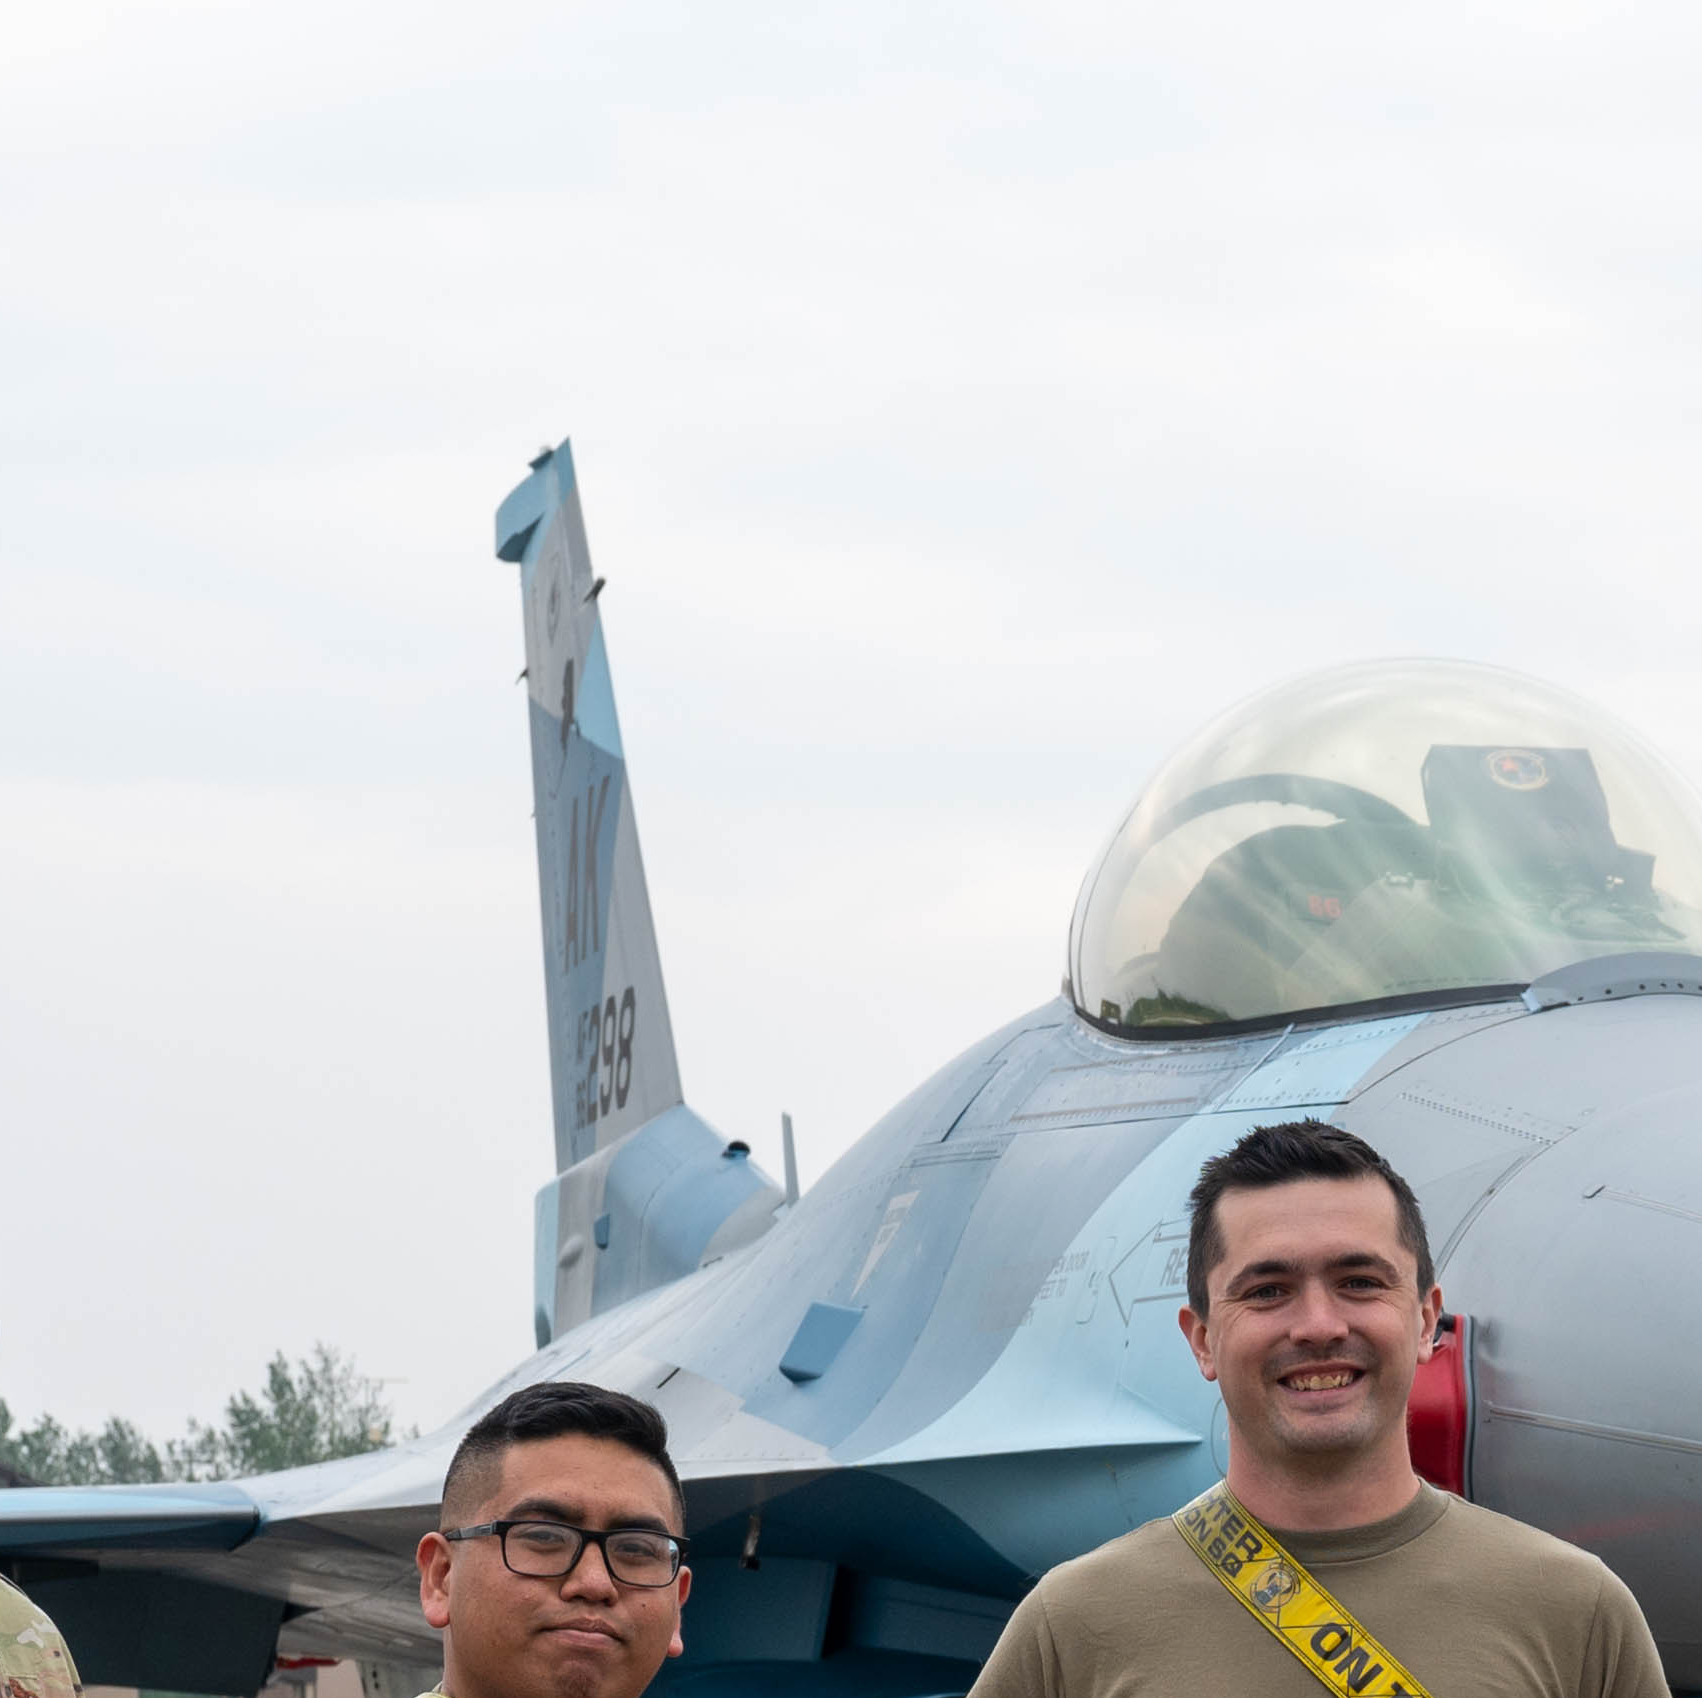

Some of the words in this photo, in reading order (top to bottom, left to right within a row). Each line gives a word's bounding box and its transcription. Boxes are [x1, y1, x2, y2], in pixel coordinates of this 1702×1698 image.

[564, 775, 610, 975] AK
[587, 985, 636, 1126] 298
[1207, 1535, 1243, 1578] SQ
[1310, 1622, 1383, 1693] ON
